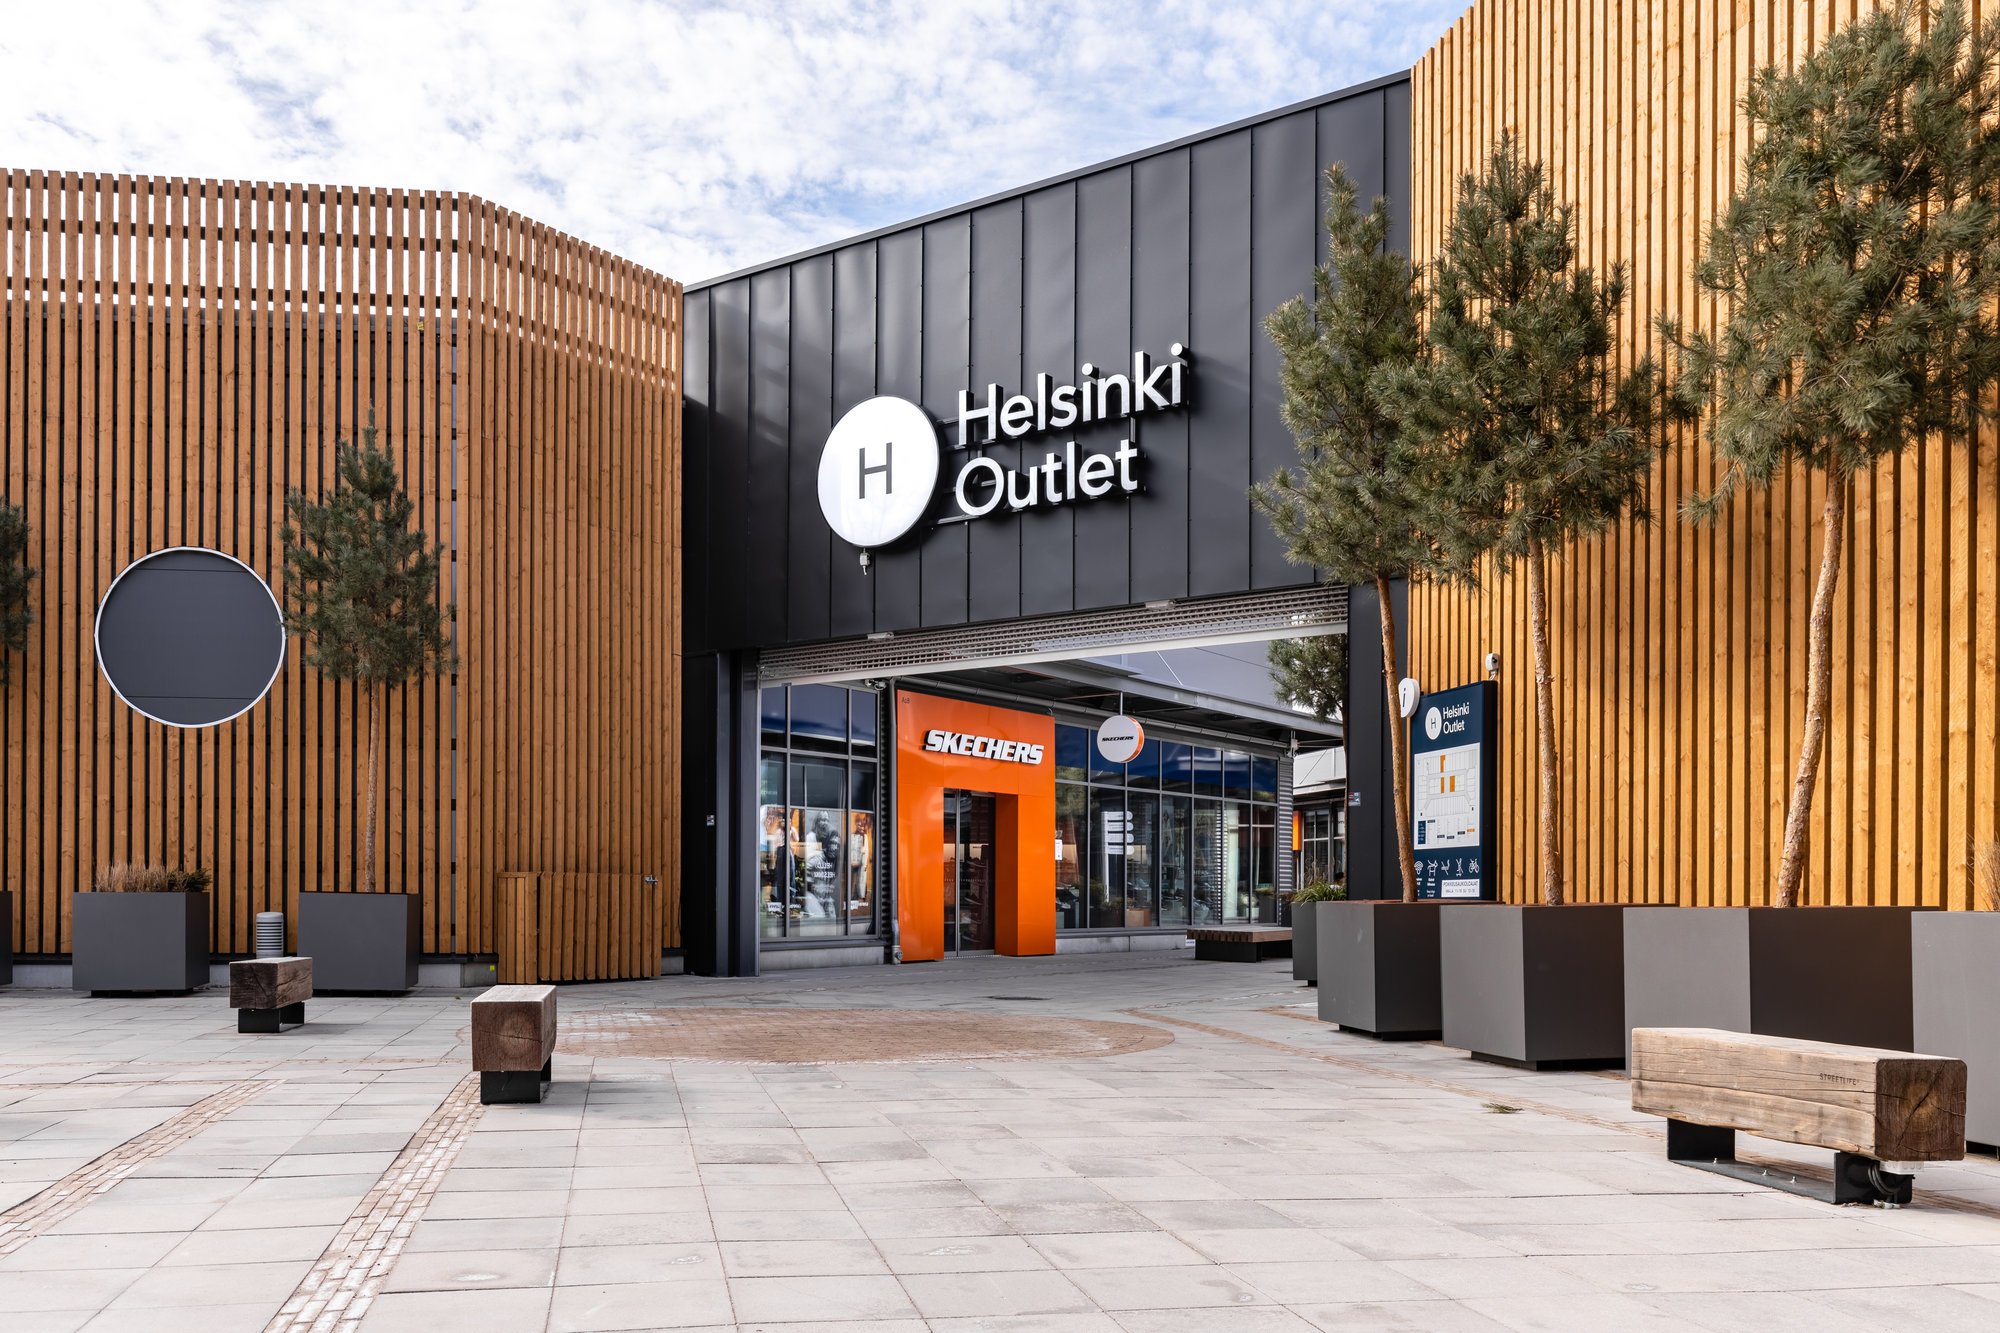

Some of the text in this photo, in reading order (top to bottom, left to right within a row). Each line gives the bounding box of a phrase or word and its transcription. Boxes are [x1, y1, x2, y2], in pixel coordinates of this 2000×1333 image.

[957, 342, 1184, 447] Helsinki
[858, 441, 893, 500] H
[955, 438, 1139, 517] Outlet
[1430, 717, 1437, 730] H
[1442, 701, 1470, 720] Helsinki
[1443, 719, 1465, 734] Outlet
[925, 729, 1045, 765] SKECHERS
